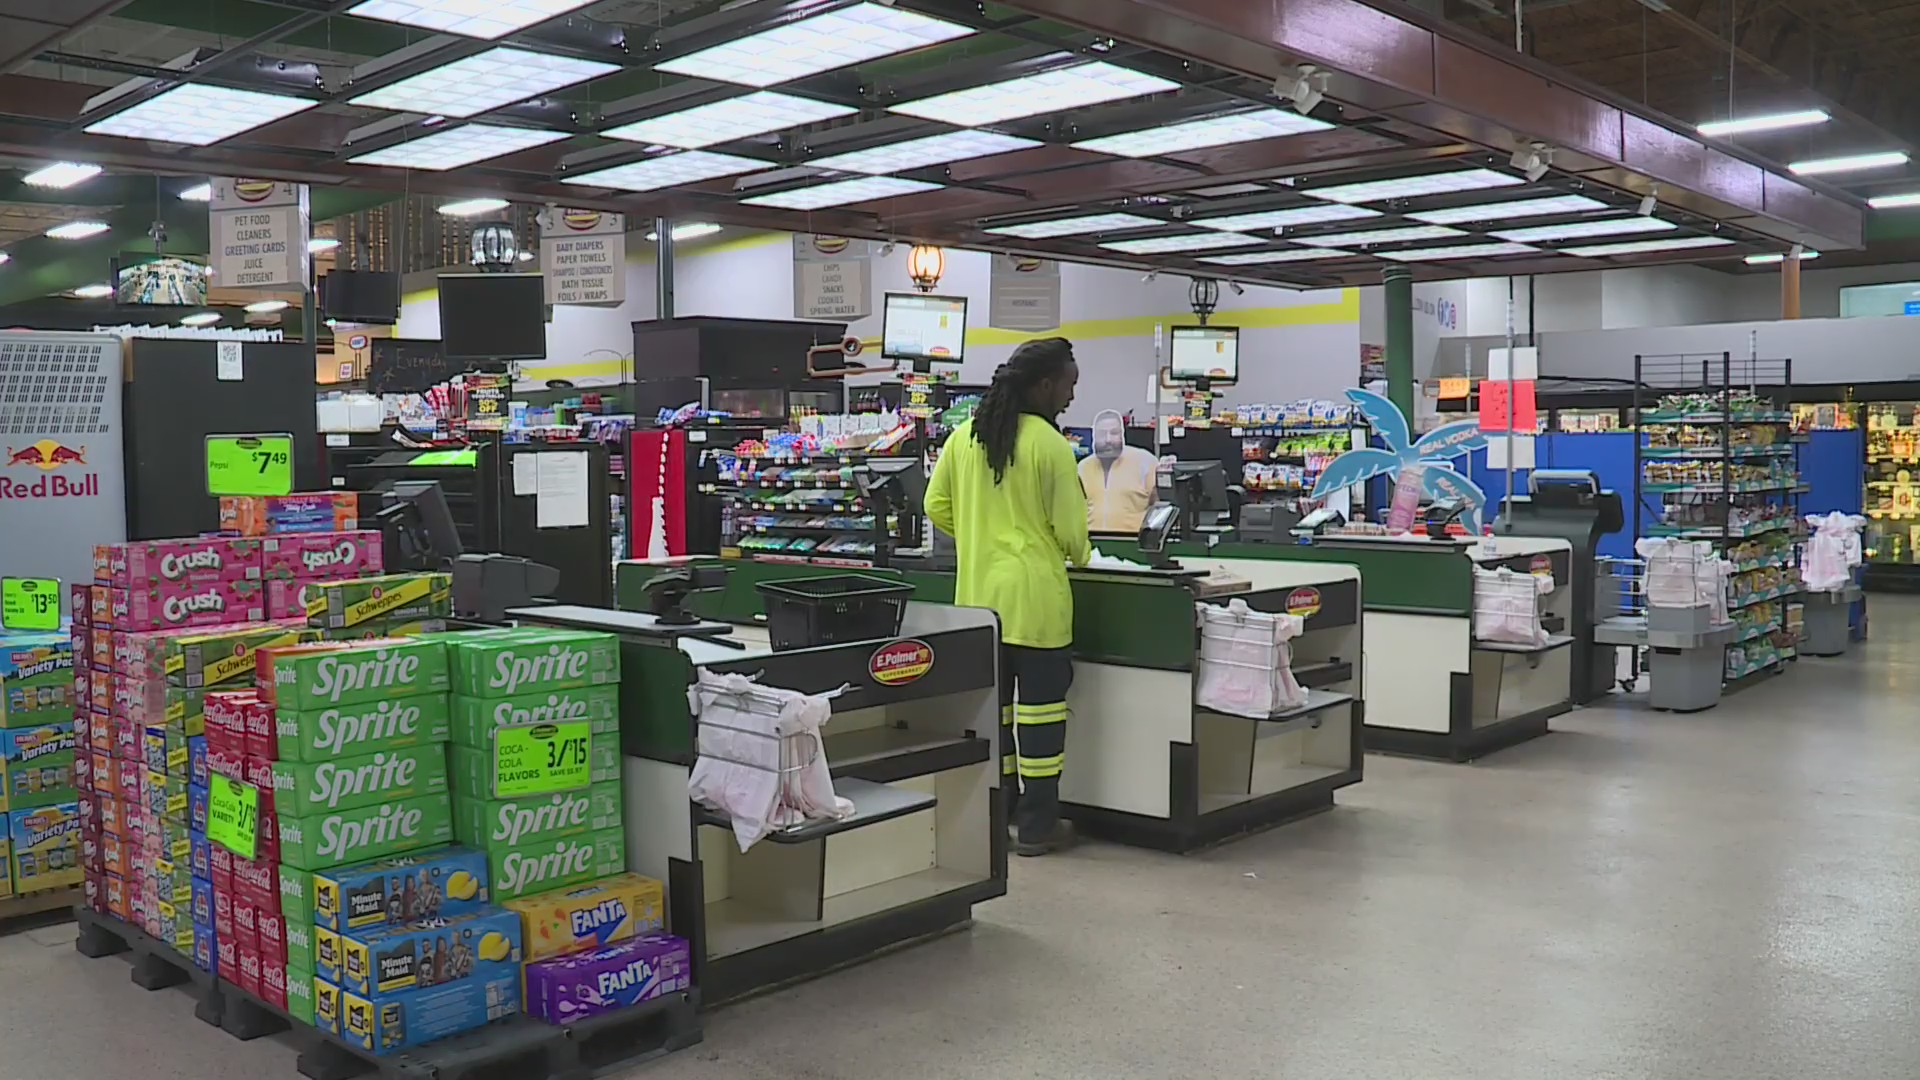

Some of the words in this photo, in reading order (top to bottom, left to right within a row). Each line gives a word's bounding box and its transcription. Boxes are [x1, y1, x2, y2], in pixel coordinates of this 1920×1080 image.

[235, 216, 248, 226] PET
[250, 215, 271, 225] FOOD
[236, 229, 272, 241] CLEANERS
[225, 244, 260, 256] GREETING
[262, 242, 286, 253] CARDS
[556, 243, 574, 253] BABY
[575, 241, 605, 252] DIAPERS
[243, 258, 264, 270] JUICE
[556, 255, 578, 265] PAPER
[580, 253, 607, 264] TOWELS
[823, 264, 841, 272] CHIPS
[236, 271, 274, 284] DETERGENT
[561, 280, 579, 290] BATH
[581, 278, 604, 288] TISSUE
[822, 275, 842, 283] CANDY
[558, 292, 577, 302] FOILS
[583, 290, 608, 300] WRAPS
[822, 285, 845, 293] SNACKS
[817, 295, 844, 305] COOKIES
[810, 306, 834, 316] SPRING
[834, 305, 856, 315] WATER
[1419, 440, 1445, 454] REAL
[1445, 427, 1478, 446] VODKA
[209, 461, 229, 470] Pepsi
[0, 475, 47, 499] Red
[52, 473, 98, 497] Bull
[160, 546, 223, 580] Crush
[302, 541, 356, 572] Crush
[163, 588, 225, 623] Crush
[355, 590, 403, 621] Schweppes
[18, 661, 54, 680] Variety
[273, 665, 297, 687] Sprite
[311, 649, 420, 703] Sprite
[489, 644, 589, 695] Sprite
[882, 666, 923, 679] SUPERMARKET
[494, 694, 587, 726] Sprite
[276, 717, 298, 739] Sprite
[313, 701, 421, 756] Sprite
[22, 741, 58, 761] Variety
[499, 744, 523, 756] COCA
[498, 758, 522, 769] COLA
[549, 769, 566, 777] SAVE
[272, 769, 295, 791] Sprite
[309, 752, 417, 809] Sprite
[498, 769, 540, 783] FLAVORS
[212, 809, 234, 824] VARIETY
[492, 793, 590, 847] Sprite
[27, 823, 64, 848] Variety
[280, 823, 303, 844] Sprite
[315, 803, 422, 862] Sprite
[497, 840, 593, 896] Sprite
[280, 874, 304, 898] Sprite
[351, 891, 383, 906] Minute
[355, 901, 379, 914] Maid
[570, 898, 626, 934] FANTA
[286, 924, 310, 949] Sprite
[381, 955, 414, 970] Minute
[385, 965, 410, 979] Maid
[286, 974, 311, 1000] Sprite
[598, 959, 653, 996] FANTA
